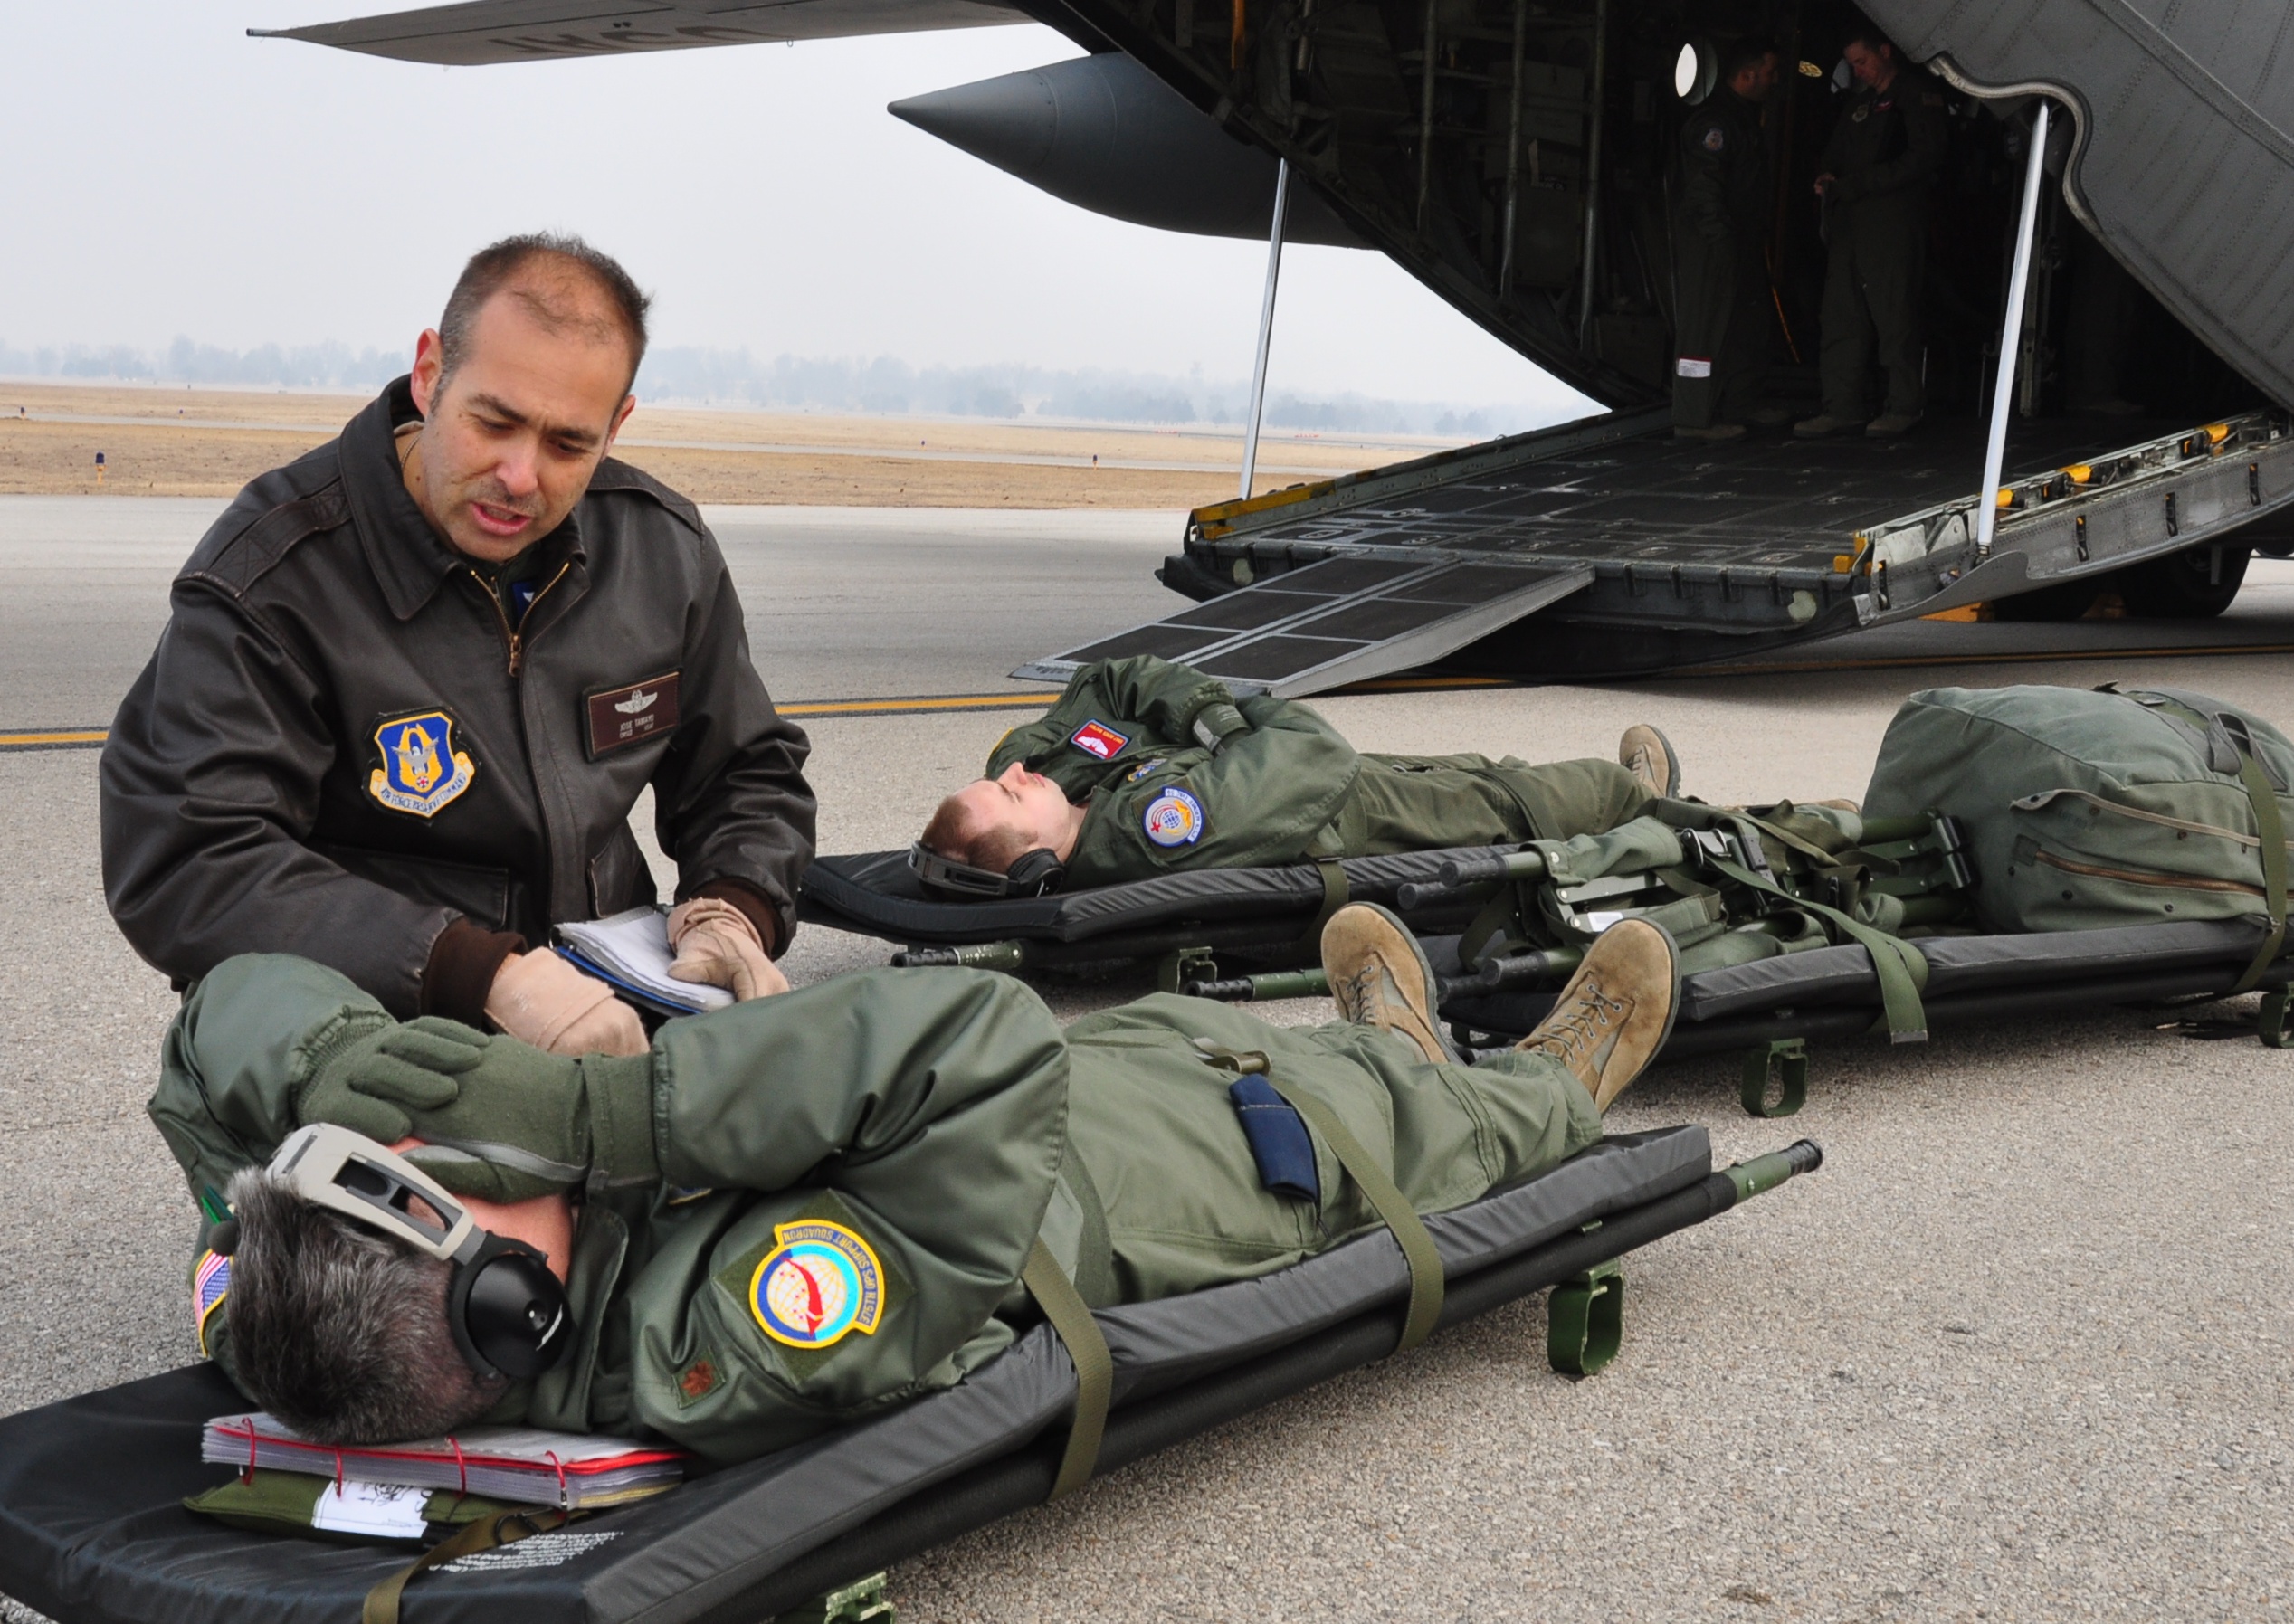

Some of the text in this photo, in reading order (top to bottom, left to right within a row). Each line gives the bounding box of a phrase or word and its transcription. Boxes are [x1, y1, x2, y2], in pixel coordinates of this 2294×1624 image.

[783, 1228, 834, 1243] SQUADRON
[832, 1233, 871, 1270] SUPPORT
[861, 1268, 878, 1290] OPS
